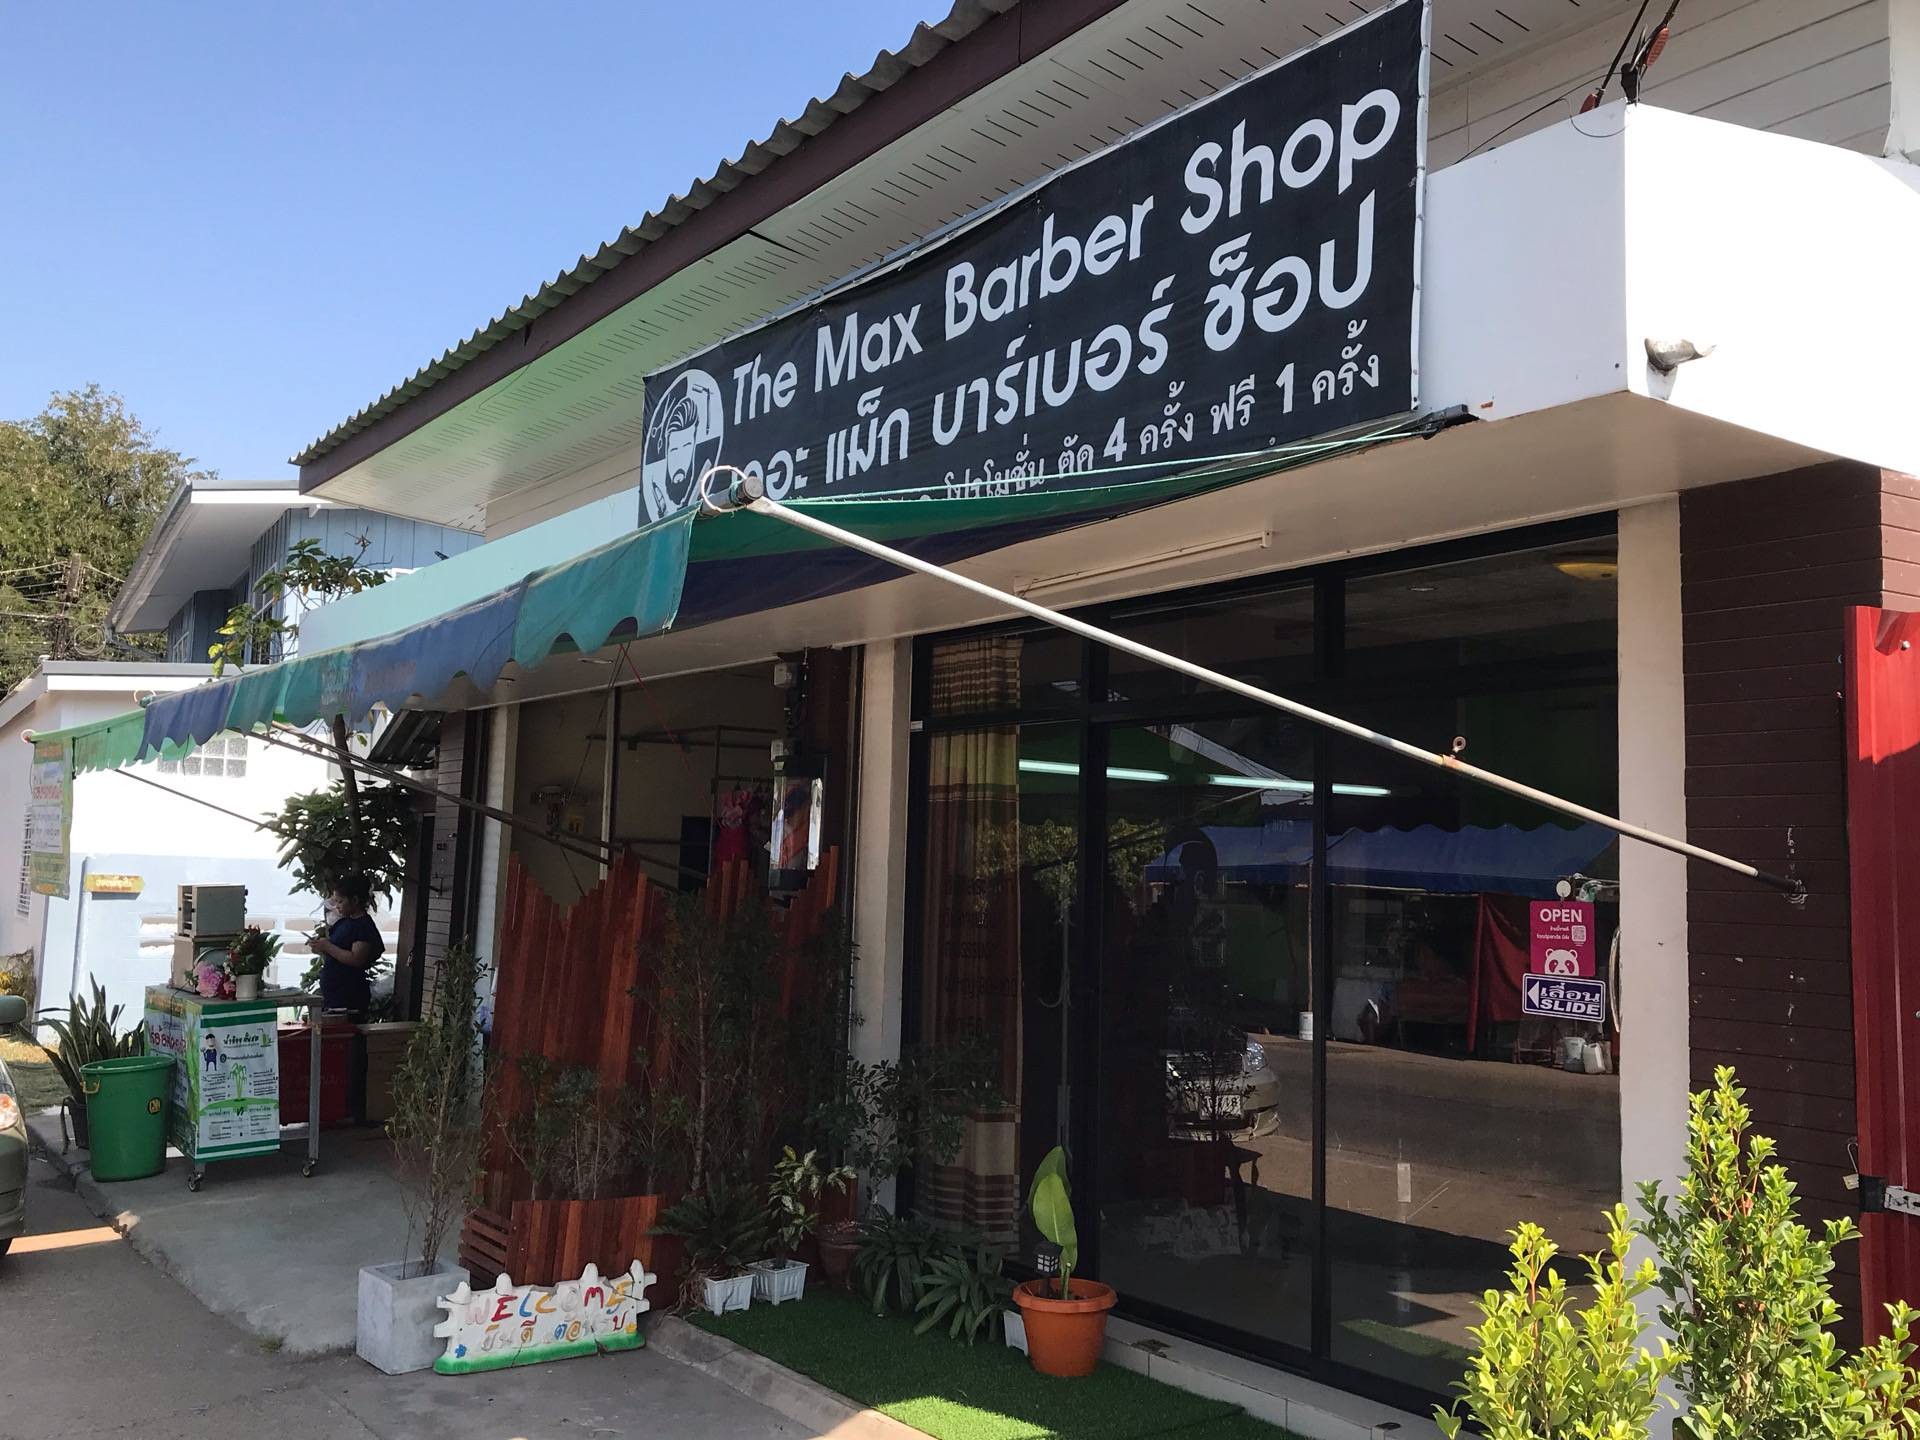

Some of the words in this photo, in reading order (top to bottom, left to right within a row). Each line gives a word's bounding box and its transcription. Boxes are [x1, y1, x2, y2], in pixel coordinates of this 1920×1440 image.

[732, 353, 798, 426] The
[814, 304, 923, 393] Max
[945, 195, 1154, 341] Barber
[1180, 88, 1401, 235] Shop
[825, 385, 910, 484] แม็ก
[932, 274, 1176, 447] บาร์เบอร์
[1203, 188, 1376, 352] ช็อป
[1057, 433, 1095, 479] ตัด
[1102, 417, 1128, 463] 4
[1139, 380, 1194, 455] ครั้ง
[1210, 374, 1256, 435] ฟรี
[1275, 363, 1295, 415] 1
[1311, 319, 1380, 405] ครั้ง
[1539, 908, 1583, 923] OPEN
[1540, 999, 1600, 1016] SLIDE
[465, 1280, 634, 1325] WELCOME
